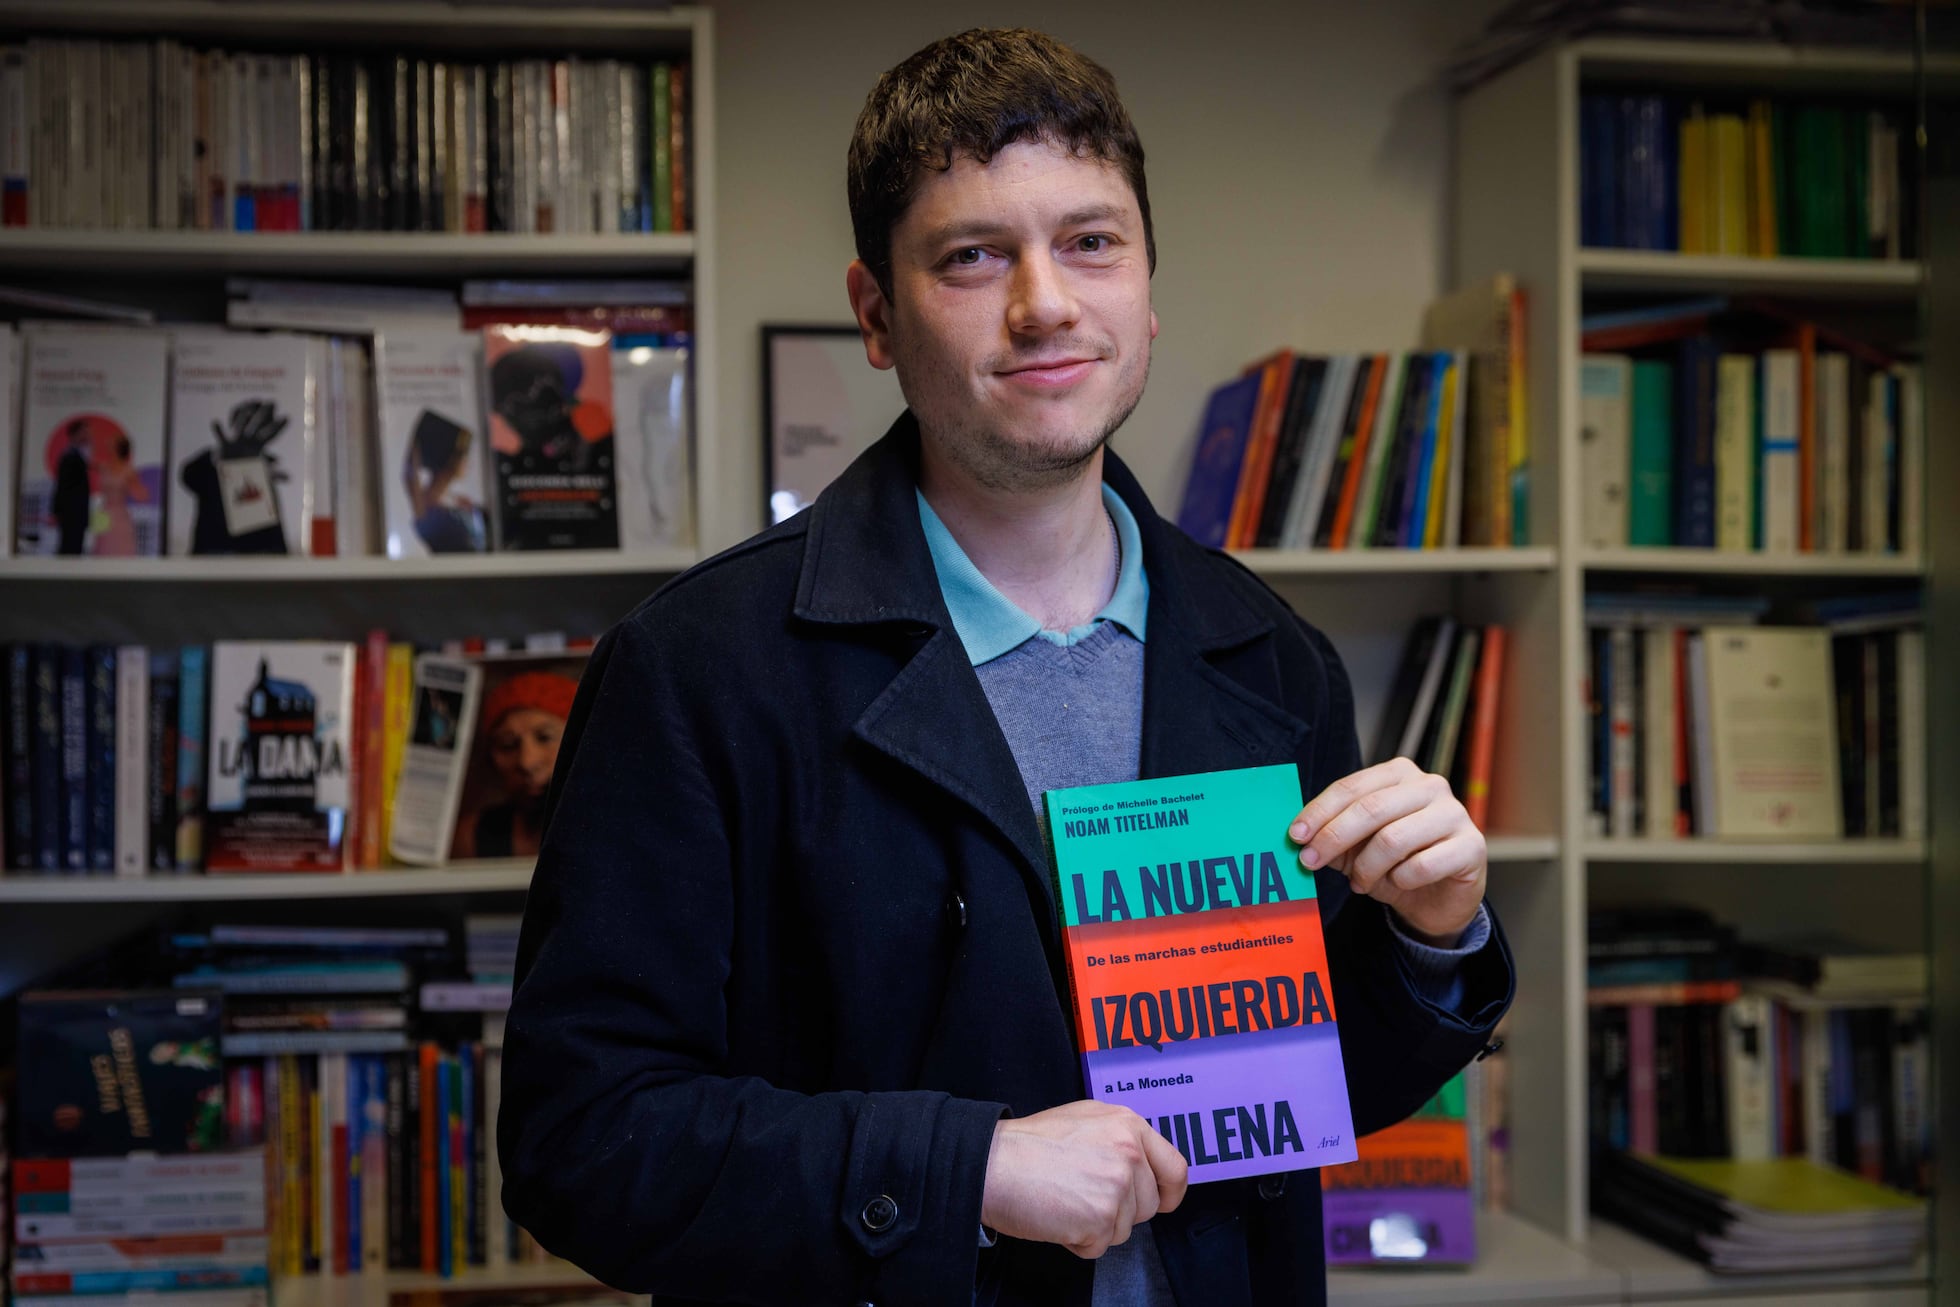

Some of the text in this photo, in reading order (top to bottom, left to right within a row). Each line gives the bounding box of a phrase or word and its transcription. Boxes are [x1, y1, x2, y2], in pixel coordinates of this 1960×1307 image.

[1062, 792, 1205, 815] Prólogo de Michelle Bachelet
[1064, 808, 1190, 839] NOAM TITELMAN
[1071, 851, 1290, 924] LA NUEVA
[1087, 934, 1294, 967] De las marchas estudiantiles
[1090, 971, 1334, 1053] IZQUIERDA
[1104, 1073, 1194, 1094] a La Moneda
[1316, 1136, 1340, 1150] Ariel
